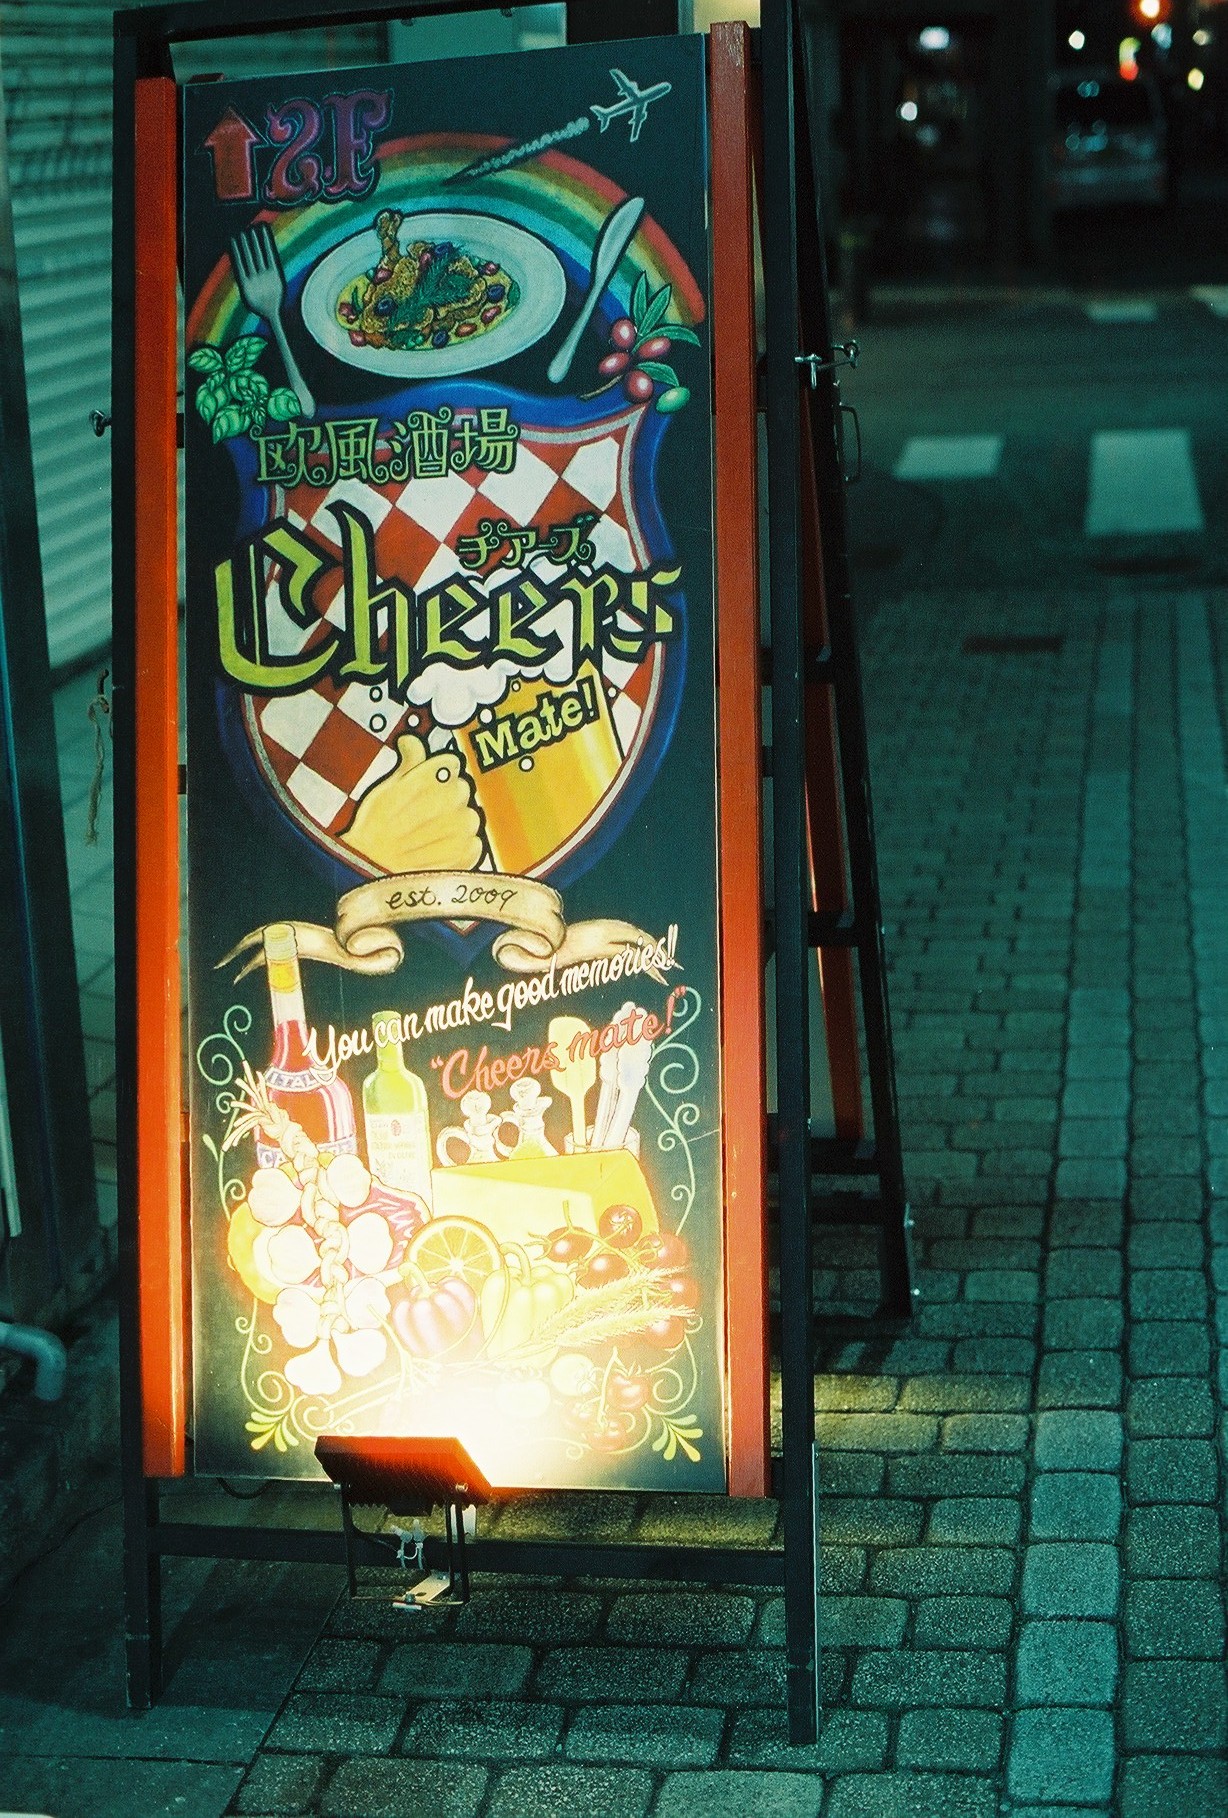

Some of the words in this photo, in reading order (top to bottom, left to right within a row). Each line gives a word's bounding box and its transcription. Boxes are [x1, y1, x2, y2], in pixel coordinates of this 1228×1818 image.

[264, 91, 391, 200] 2F
[250, 406, 518, 488] 欧風酒場
[212, 503, 683, 693] Cheers
[474, 682, 597, 768] Mate!
[386, 886, 442, 910] est.
[451, 884, 518, 912] 2009
[302, 1024, 374, 1086] You
[374, 1012, 424, 1048] can
[424, 977, 496, 1034] make
[490, 953, 560, 1031] good
[559, 923, 679, 996] memories!!
[268, 1070, 318, 1088] ITAL
